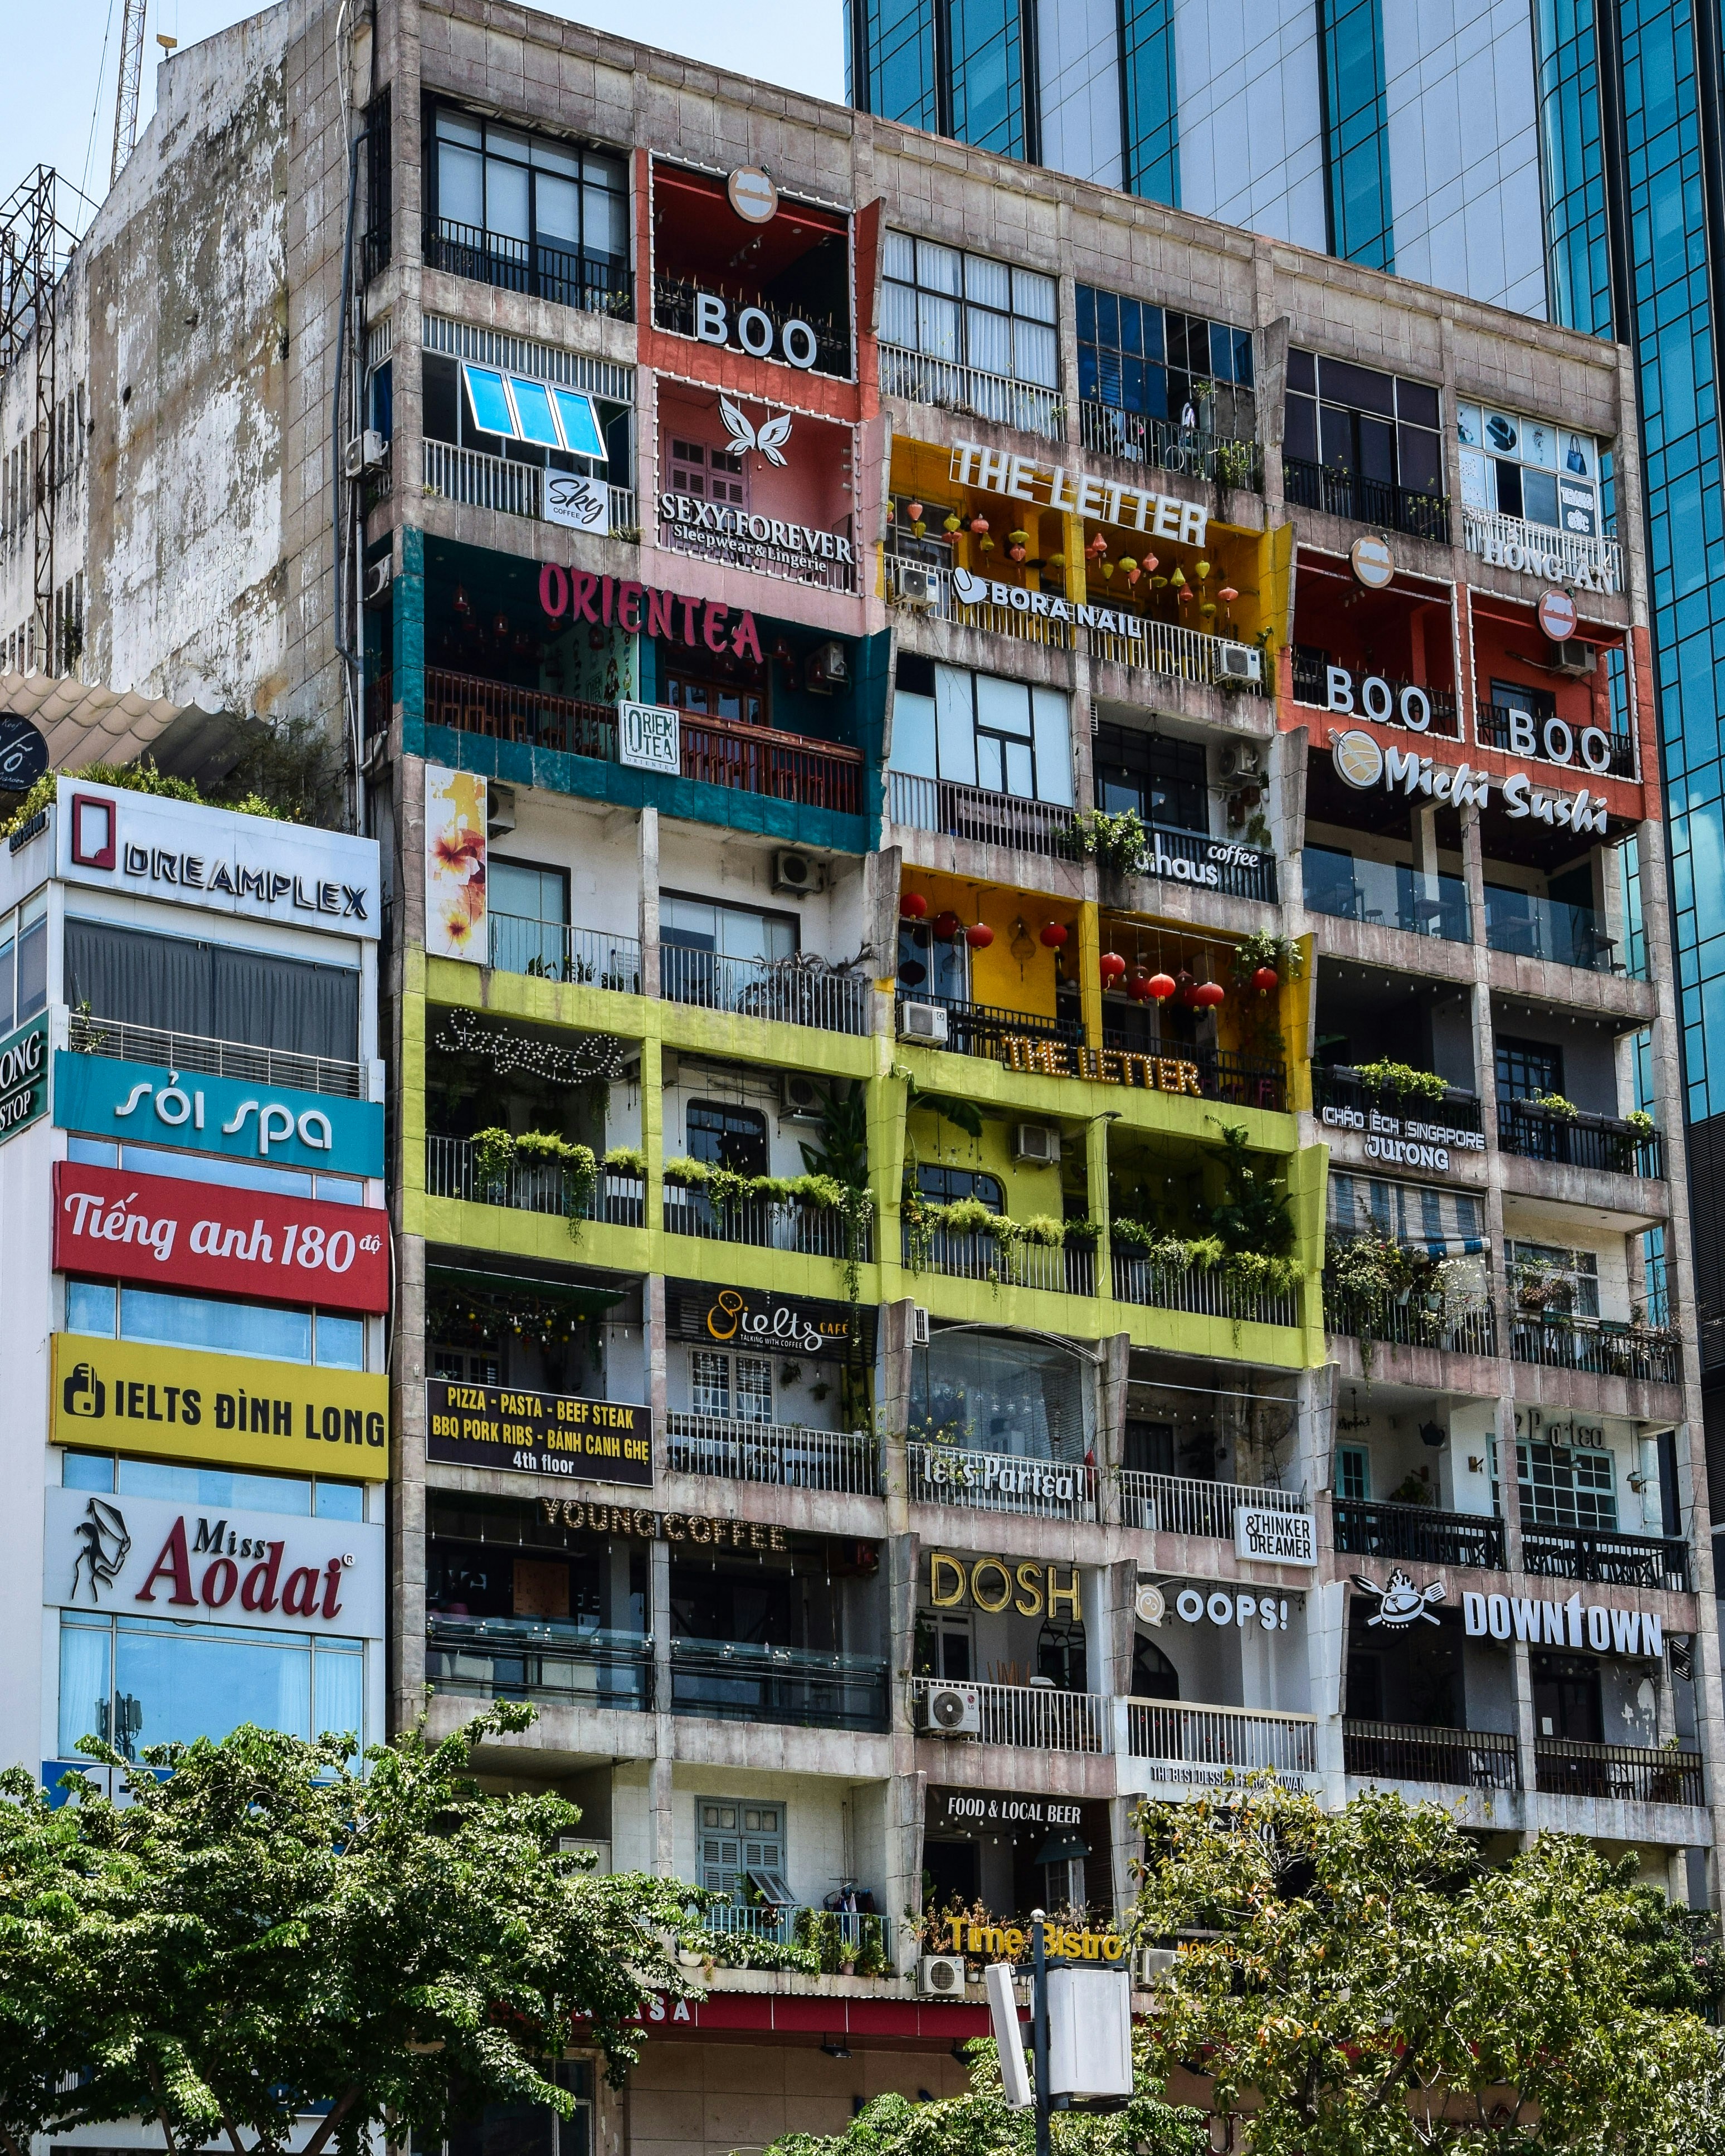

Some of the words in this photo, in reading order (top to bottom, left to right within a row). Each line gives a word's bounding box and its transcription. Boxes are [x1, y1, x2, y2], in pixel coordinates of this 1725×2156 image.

[695, 291, 817, 369] BOO
[549, 478, 604, 524] Sky
[553, 507, 580, 519] COFFEE
[952, 439, 1034, 502] THE
[1051, 466, 1208, 548] LETTER
[661, 493, 730, 531] SEXY
[737, 511, 855, 565] FOREVER
[539, 562, 764, 664] ORIENTEA
[992, 582, 1070, 622] BORA
[1075, 604, 1142, 639] NAIL
[1327, 665, 1430, 732] BOO
[628, 709, 673, 752] ORIEN
[643, 734, 673, 760] TEA
[626, 757, 675, 772] ORIENTEA
[1385, 745, 1489, 810] Michi
[1503, 773, 1607, 835] Sushi
[1207, 846, 1259, 867] coffee
[125, 841, 369, 920] DREAMPLEX
[1003, 1035, 1071, 1077] THE
[1078, 1045, 1202, 1096] LETTER
[0, 1090, 31, 1131] STOP
[1405, 1120, 1485, 1151] SINGAPORE
[64, 1192, 178, 1262] Tiếng
[190, 1220, 274, 1263] anh
[281, 1224, 356, 1273] 180
[740, 1334, 763, 1344] TALKING
[781, 1340, 802, 1348] COFFEE
[820, 1319, 849, 1334] CAFÉ
[115, 1380, 202, 1426] IELTS
[214, 1388, 293, 1437] ĐÌNH
[306, 1403, 385, 1448] LONG
[447, 1387, 486, 1411] PIZZA
[501, 1393, 543, 1417] PASTA
[557, 1401, 588, 1423] BEEF
[592, 1405, 634, 1430] STEAK
[432, 1414, 459, 1440] BBQ
[463, 1419, 499, 1443] PORK
[503, 1423, 533, 1447] RIBS
[547, 1426, 582, 1453] BÁNH
[586, 1434, 620, 1457] CANH
[624, 1438, 649, 1466] GHẸ
[513, 1451, 537, 1470] 4th
[541, 1454, 574, 1474] floor
[193, 1517, 267, 1559] Miss
[540, 1497, 656, 1538] YOUNG
[663, 1512, 789, 1552] COFFEE
[1254, 1514, 1310, 1539] THINKER
[135, 1515, 343, 1620] Aodai
[1250, 1534, 1312, 1559] DREAMER
[931, 1552, 1081, 1622] DOSH
[1176, 1589, 1288, 1631] OOPS!
[1151, 1767, 1169, 1781] THE
[1171, 1768, 1194, 1783] BEST
[948, 1797, 985, 1818] FOOD
[988, 1802, 999, 1818] &
[1002, 1802, 1044, 1822] LOCAL
[1047, 1805, 1081, 1825] BEER
[946, 1916, 1024, 1954] Time
[1043, 1923, 1123, 1960] Bistro
